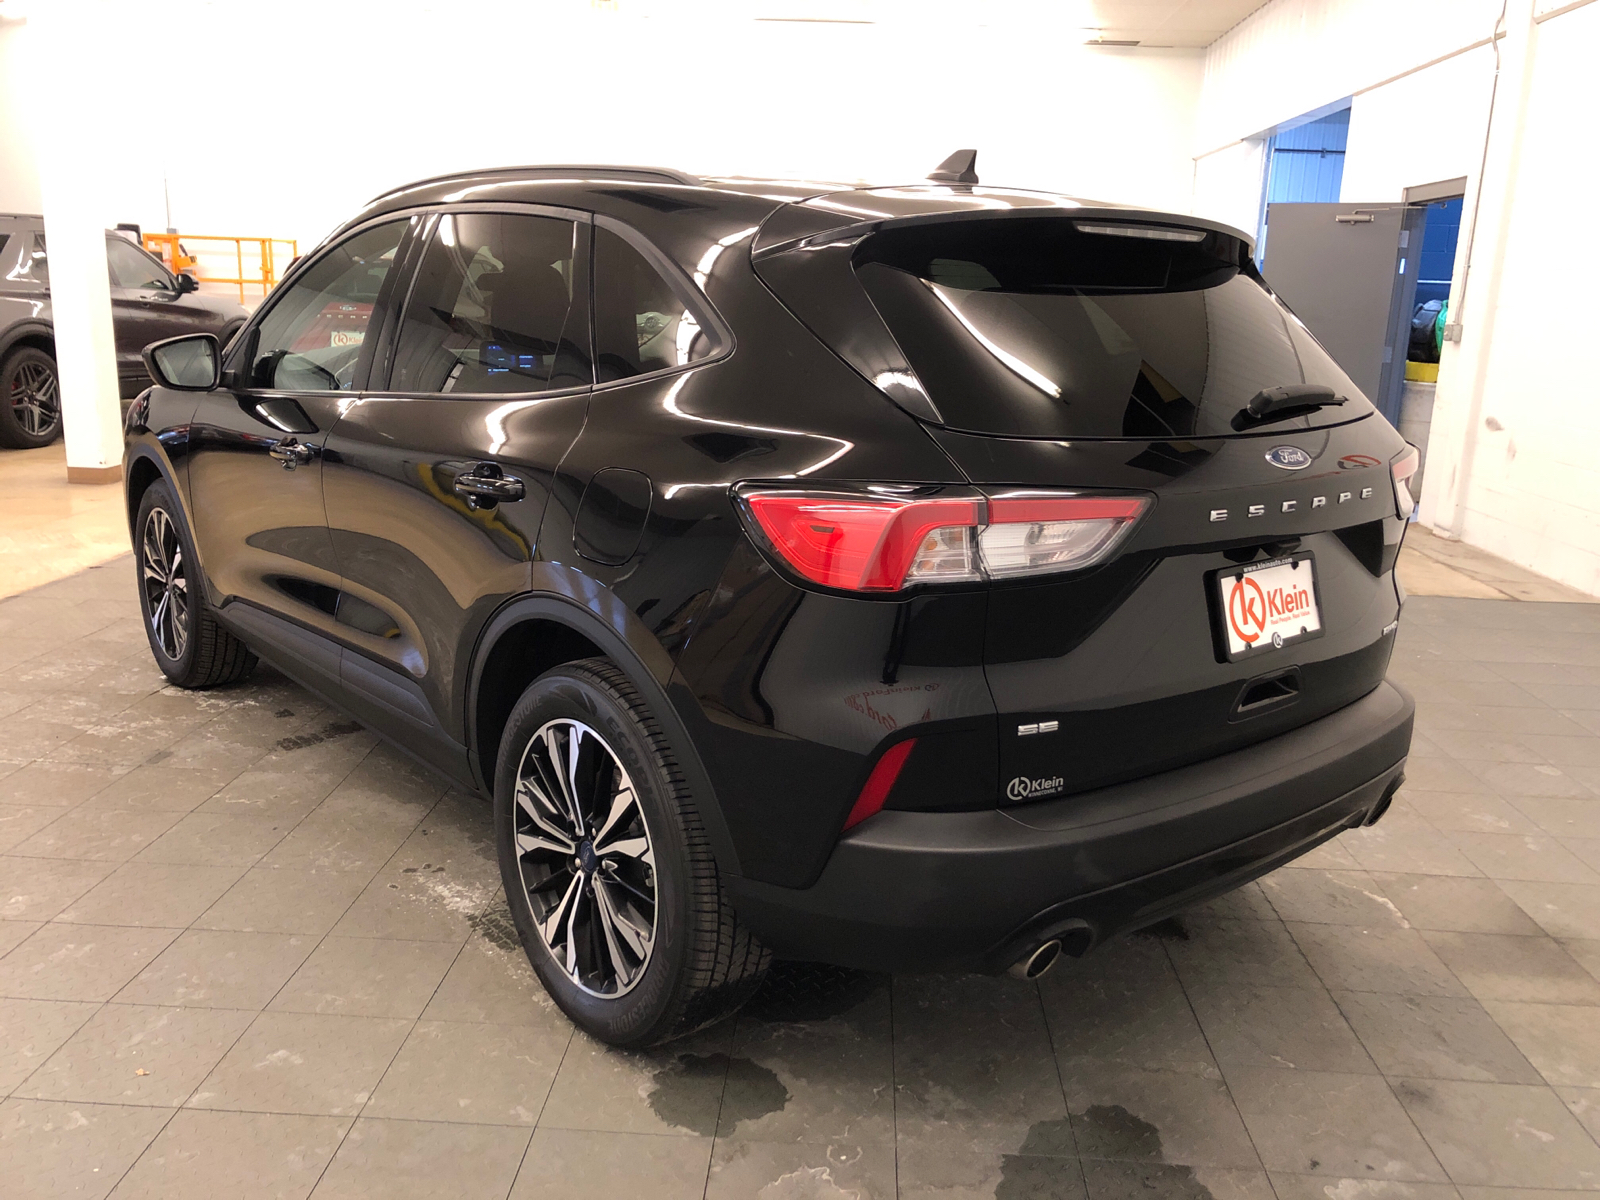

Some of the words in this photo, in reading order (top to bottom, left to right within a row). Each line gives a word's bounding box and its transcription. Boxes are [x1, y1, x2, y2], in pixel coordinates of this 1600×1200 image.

[1278, 449, 1304, 464] Ford
[1209, 487, 1372, 522] ESCAPE
[1243, 557, 1293, 573] www.kleinauto.com
[1267, 584, 1309, 618] Klein
[1017, 720, 1059, 736] SE
[1031, 776, 1064, 792] Klein
